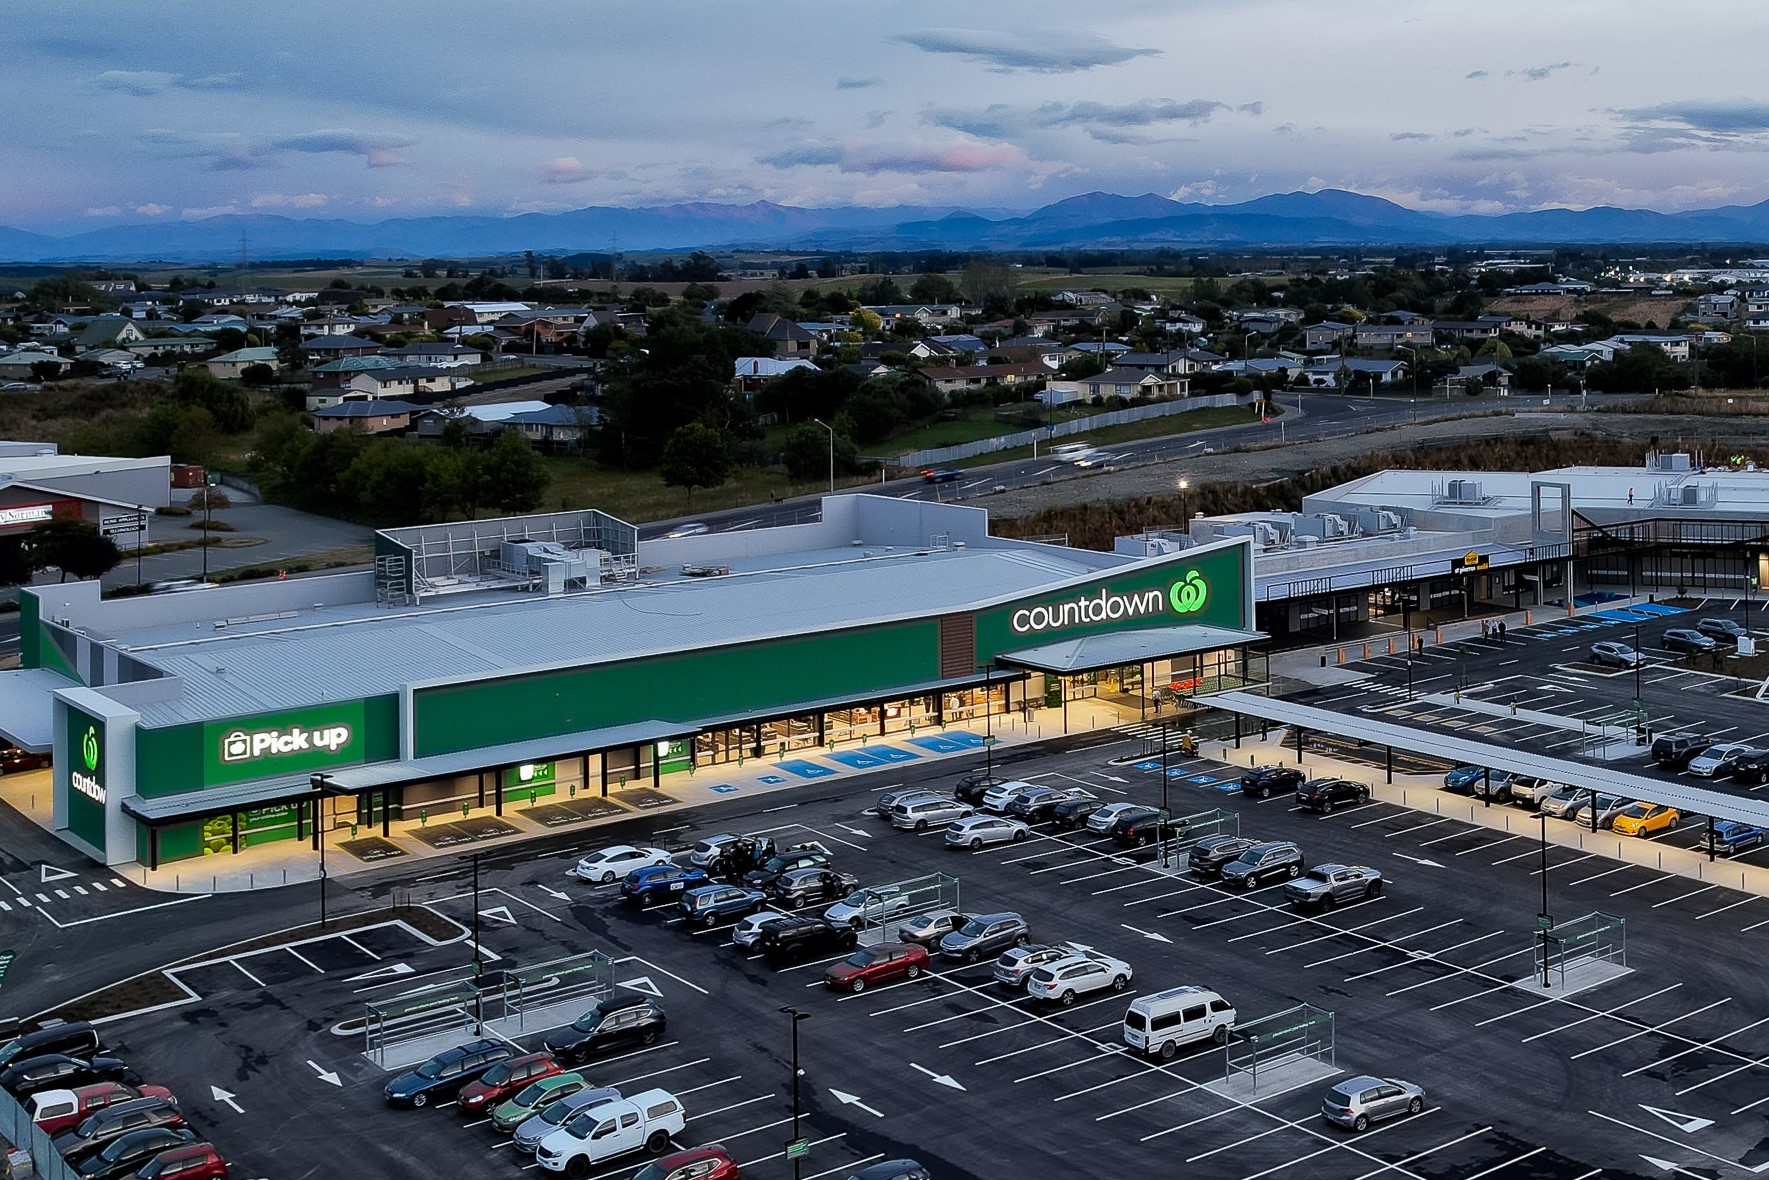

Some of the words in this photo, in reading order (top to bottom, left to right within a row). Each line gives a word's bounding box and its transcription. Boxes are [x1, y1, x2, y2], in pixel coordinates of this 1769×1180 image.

[1013, 588, 1163, 632] countdown
[252, 728, 310, 757] Pick
[312, 727, 349, 751] up
